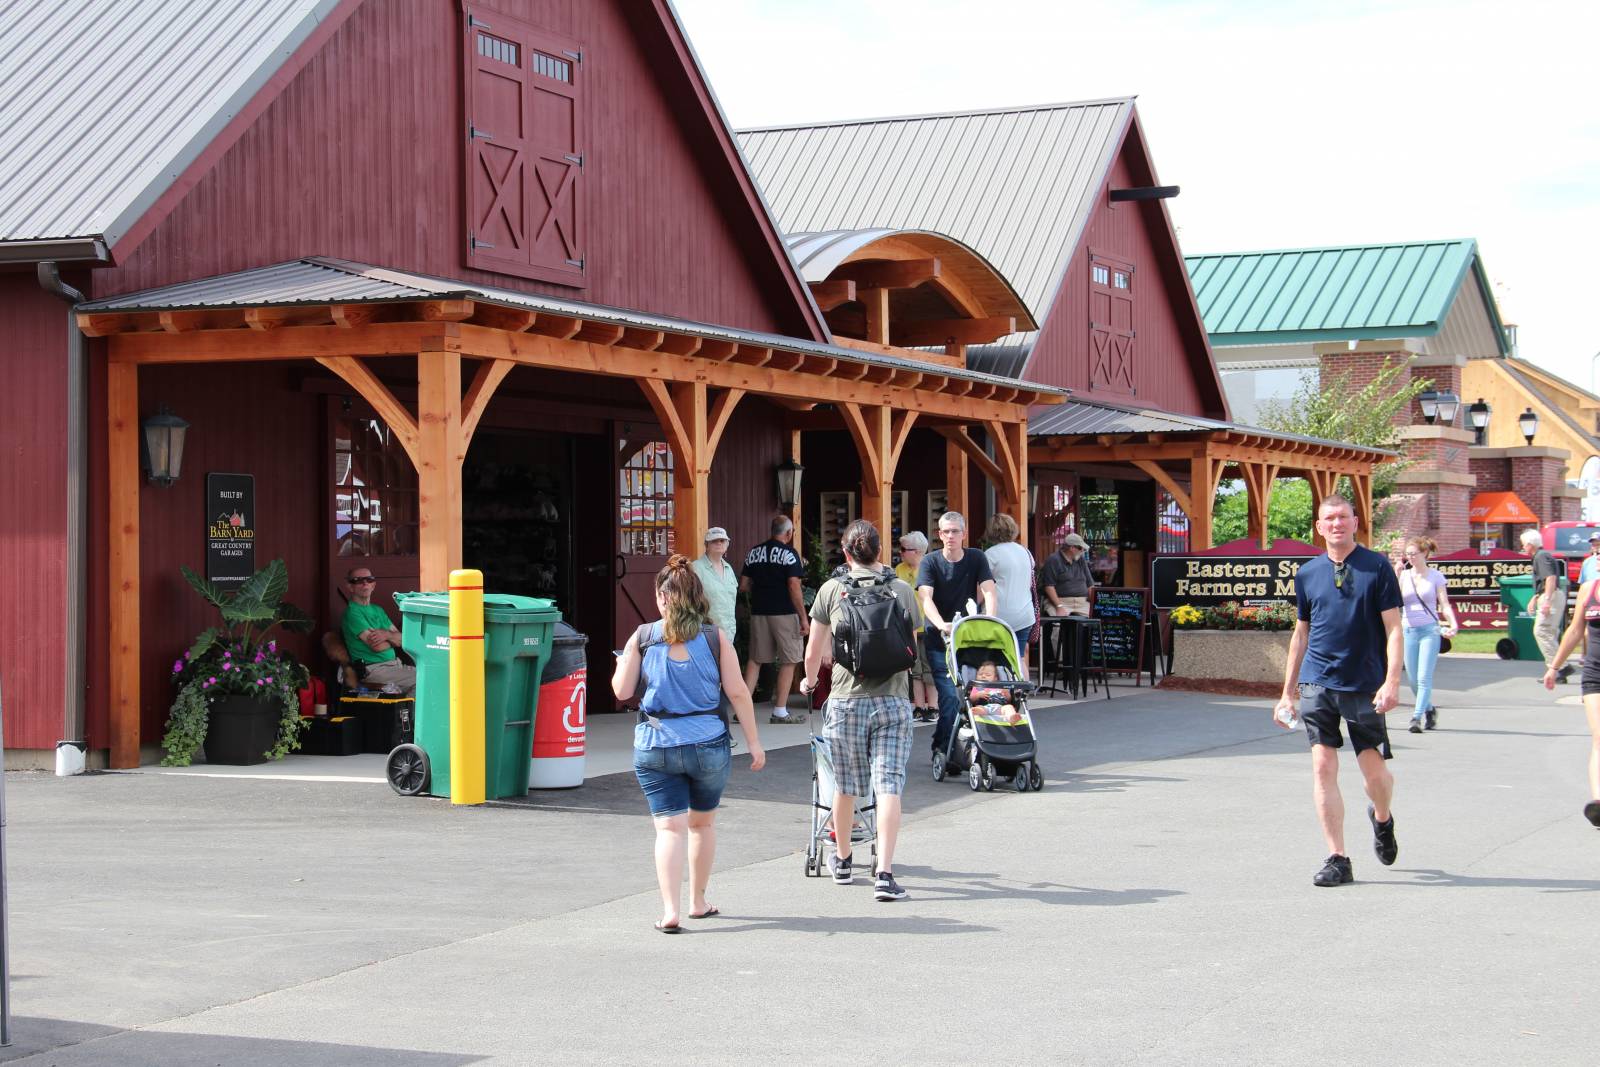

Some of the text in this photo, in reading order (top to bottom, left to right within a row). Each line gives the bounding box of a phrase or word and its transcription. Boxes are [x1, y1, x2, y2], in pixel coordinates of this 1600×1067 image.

[220, 491, 243, 499] BUILT BY
[216, 520, 230, 529] The
[210, 525, 254, 538] BARN YARD
[1186, 560, 1271, 578] Eastern
[1492, 562, 1534, 575] State
[1176, 579, 1267, 596] Farmers
[1456, 601, 1493, 613] WINE
